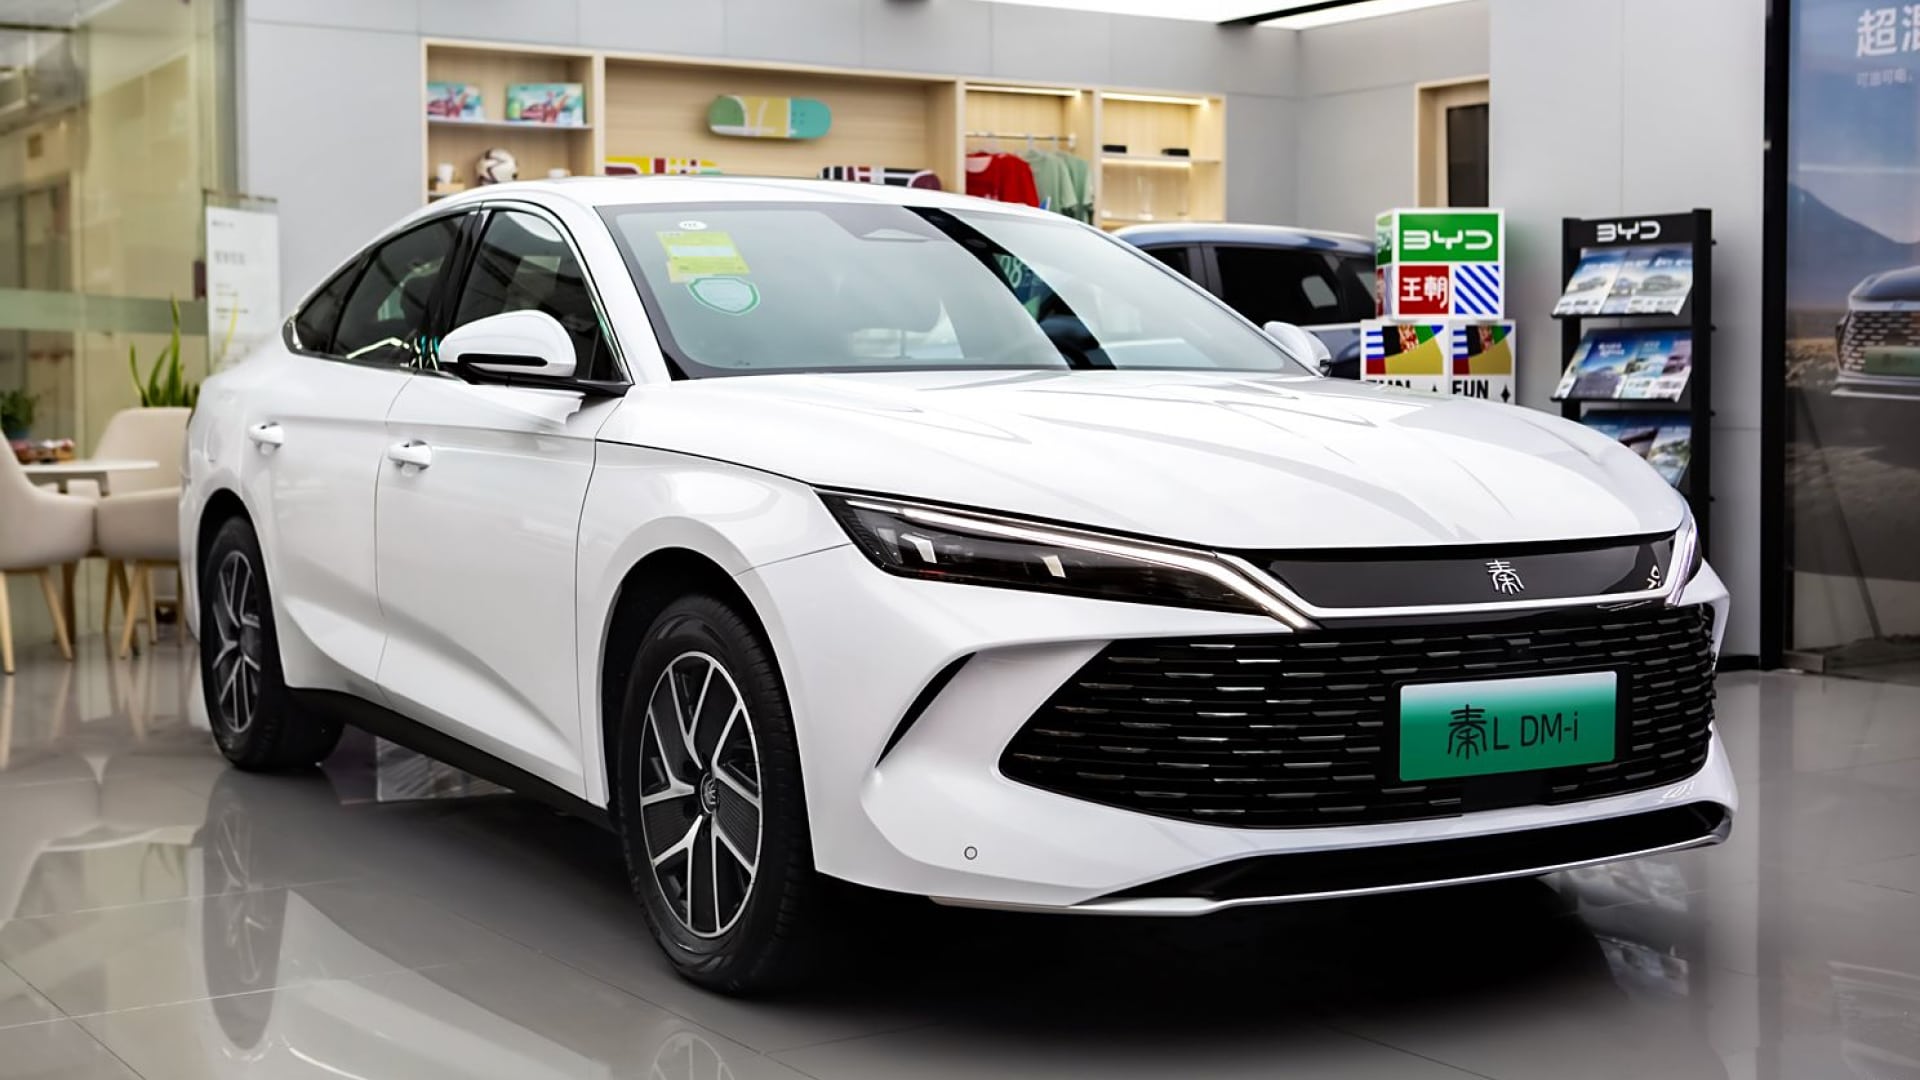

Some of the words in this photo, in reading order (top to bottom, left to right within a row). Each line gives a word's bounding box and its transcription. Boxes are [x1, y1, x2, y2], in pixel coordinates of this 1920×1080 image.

[1403, 229, 1493, 250] BYD
[1596, 220, 1661, 242] BYD
[1400, 275, 1448, 309] 王朝
[1453, 379, 1489, 399] FUN
[1485, 559, 1525, 595] 秦
[1520, 711, 1579, 747] DM-i
